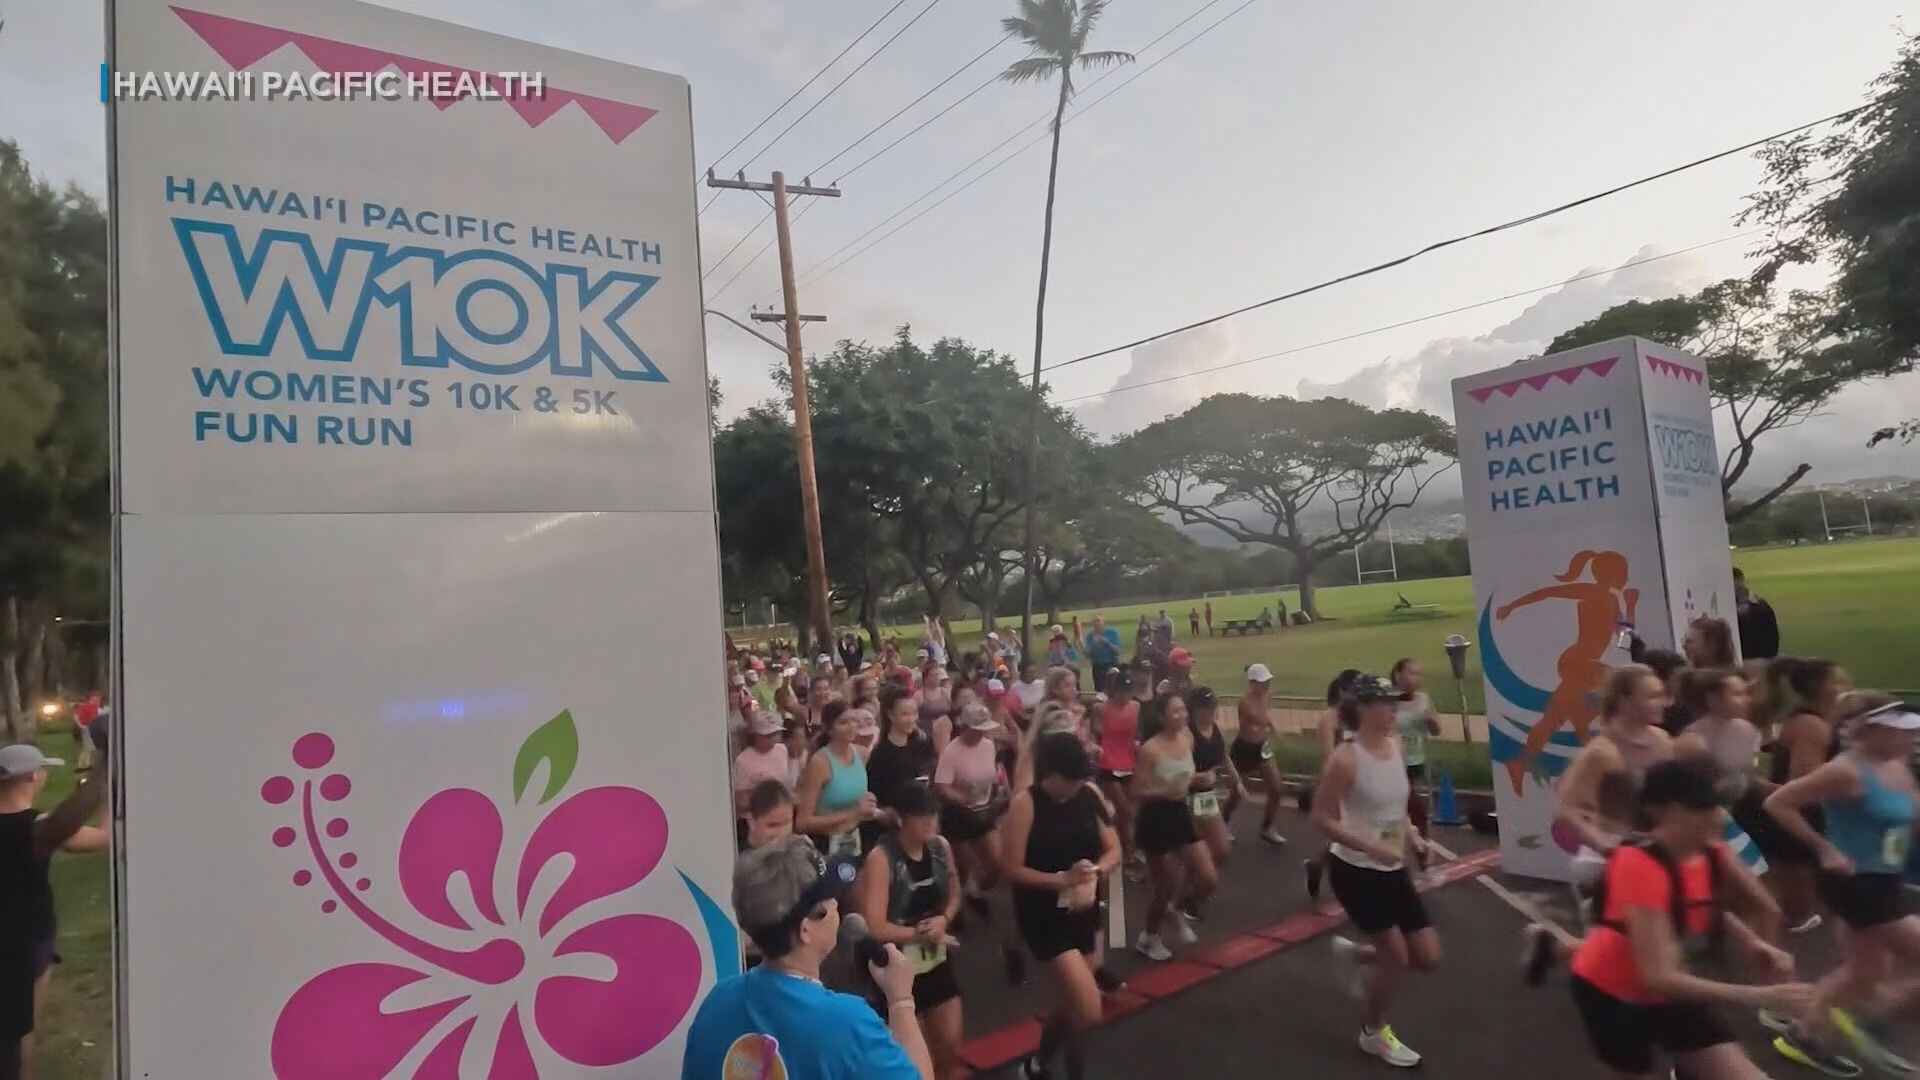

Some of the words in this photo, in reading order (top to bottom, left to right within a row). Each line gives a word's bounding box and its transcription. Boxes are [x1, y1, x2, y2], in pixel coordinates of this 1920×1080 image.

[165, 175, 348, 225] HAWAI‘I
[363, 202, 518, 246] PACIFIC
[530, 226, 663, 265] HEALTH
[170, 217, 671, 384] W10K
[192, 367, 430, 409] WOMEN’S
[446, 381, 520, 412] 10K
[533, 386, 560, 414] &
[572, 389, 620, 417] 5K
[195, 411, 299, 444] FUN
[316, 414, 413, 447] RUN
[1485, 407, 1613, 451] HAWAI‘I
[1488, 441, 1616, 481] PACIFIC
[1491, 474, 1620, 512] HEALTH
